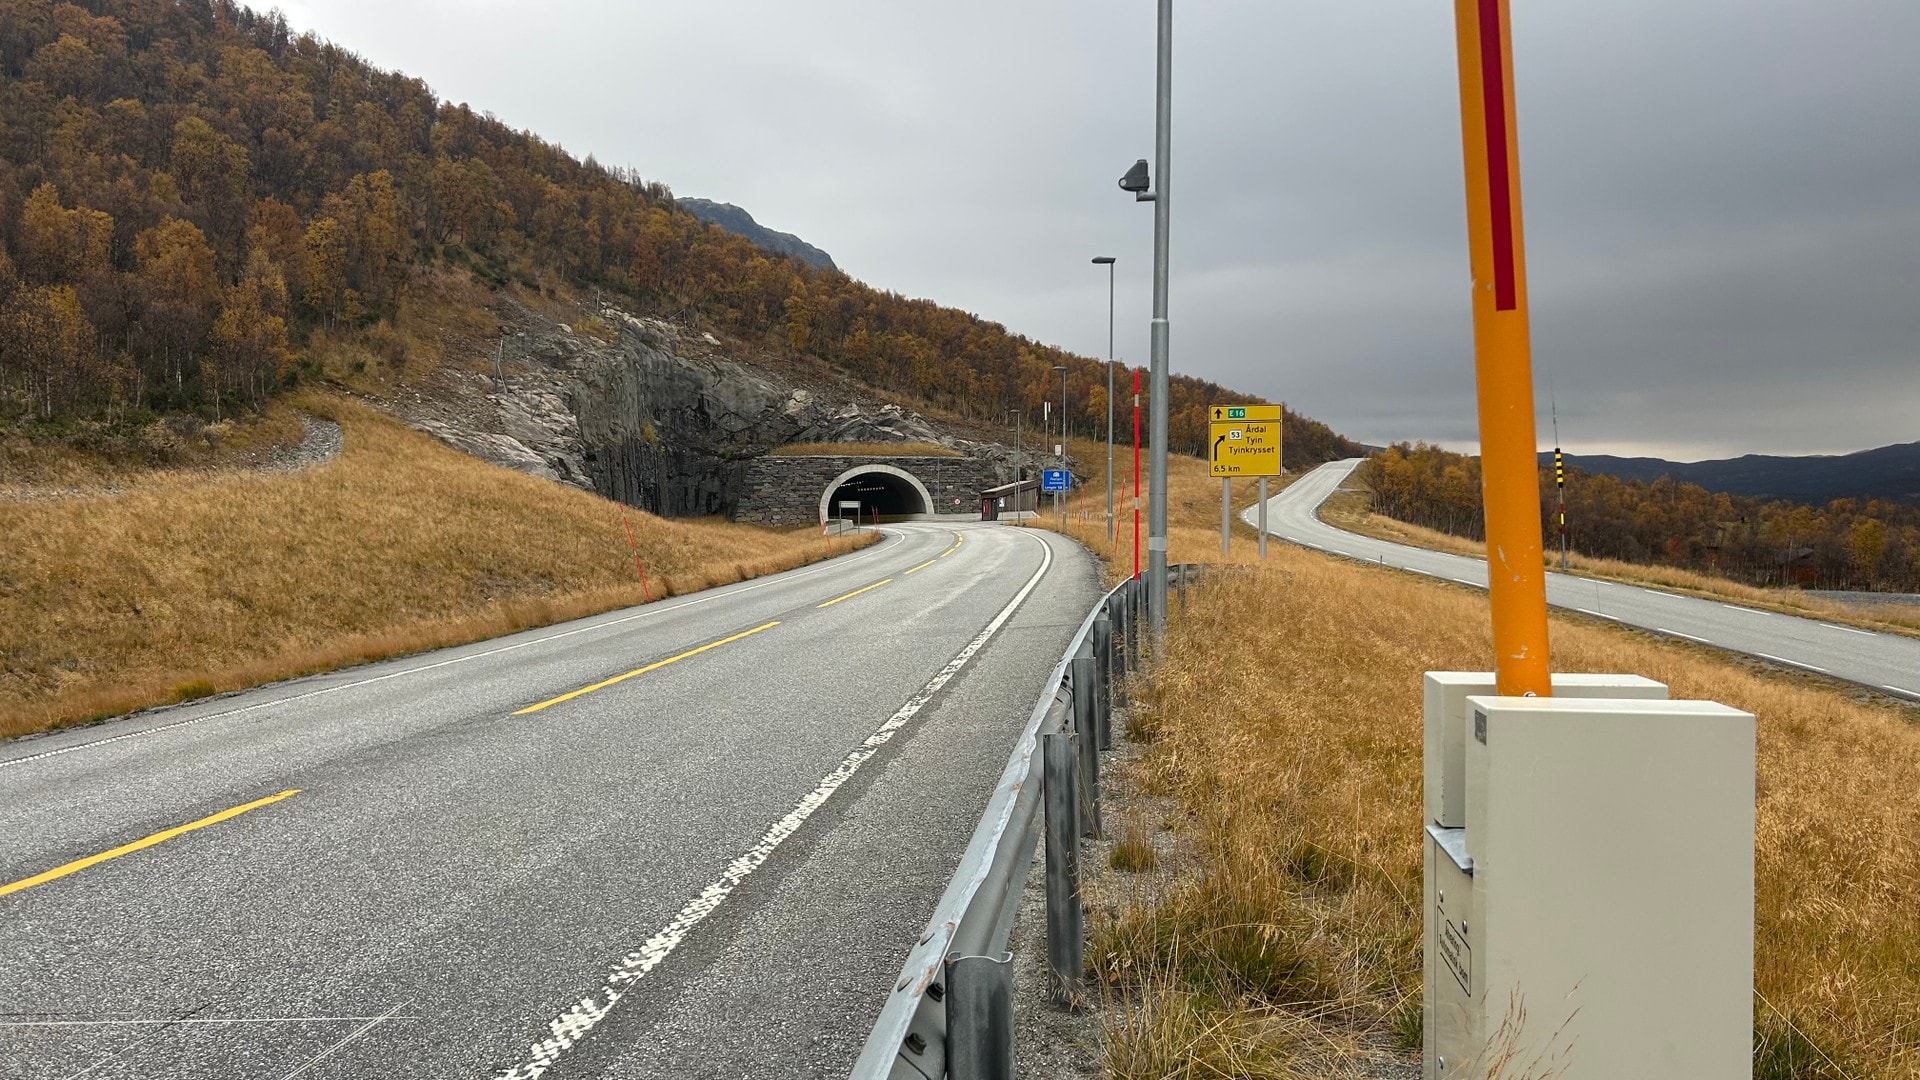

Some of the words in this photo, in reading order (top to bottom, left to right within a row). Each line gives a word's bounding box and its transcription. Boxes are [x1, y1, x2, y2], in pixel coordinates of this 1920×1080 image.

[1246, 424, 1267, 433] Årdal
[1231, 431, 1240, 439] 53
[1246, 437, 1263, 445] Tyin
[1229, 446, 1275, 455] Tyinkrysset
